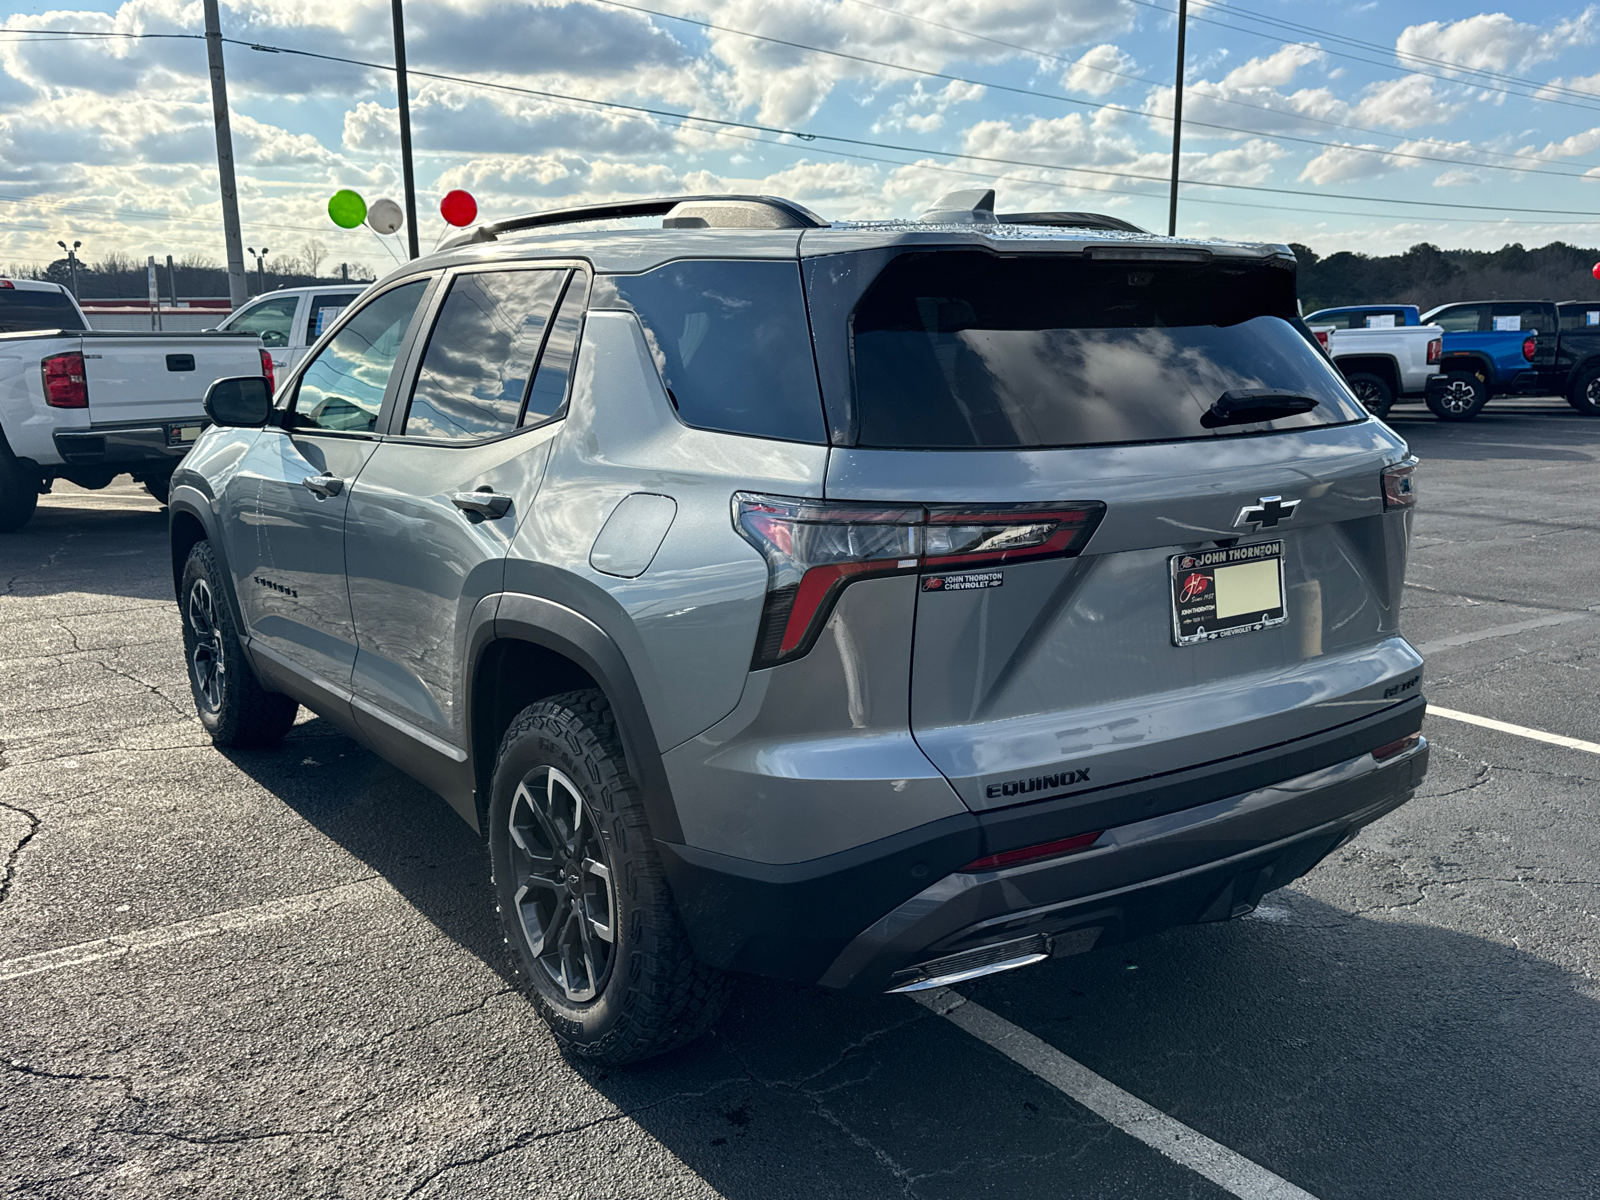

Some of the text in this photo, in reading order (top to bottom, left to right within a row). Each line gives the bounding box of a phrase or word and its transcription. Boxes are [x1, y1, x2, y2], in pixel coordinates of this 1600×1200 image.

[1199, 551, 1227, 565] JOHN
[1228, 543, 1280, 560] THORNTON
[944, 572, 1003, 583] JOHN THORNTON
[944, 581, 989, 590] CHEVROLET
[1219, 626, 1252, 638] CHEVROLET
[986, 767, 1091, 799] EQUINOX
